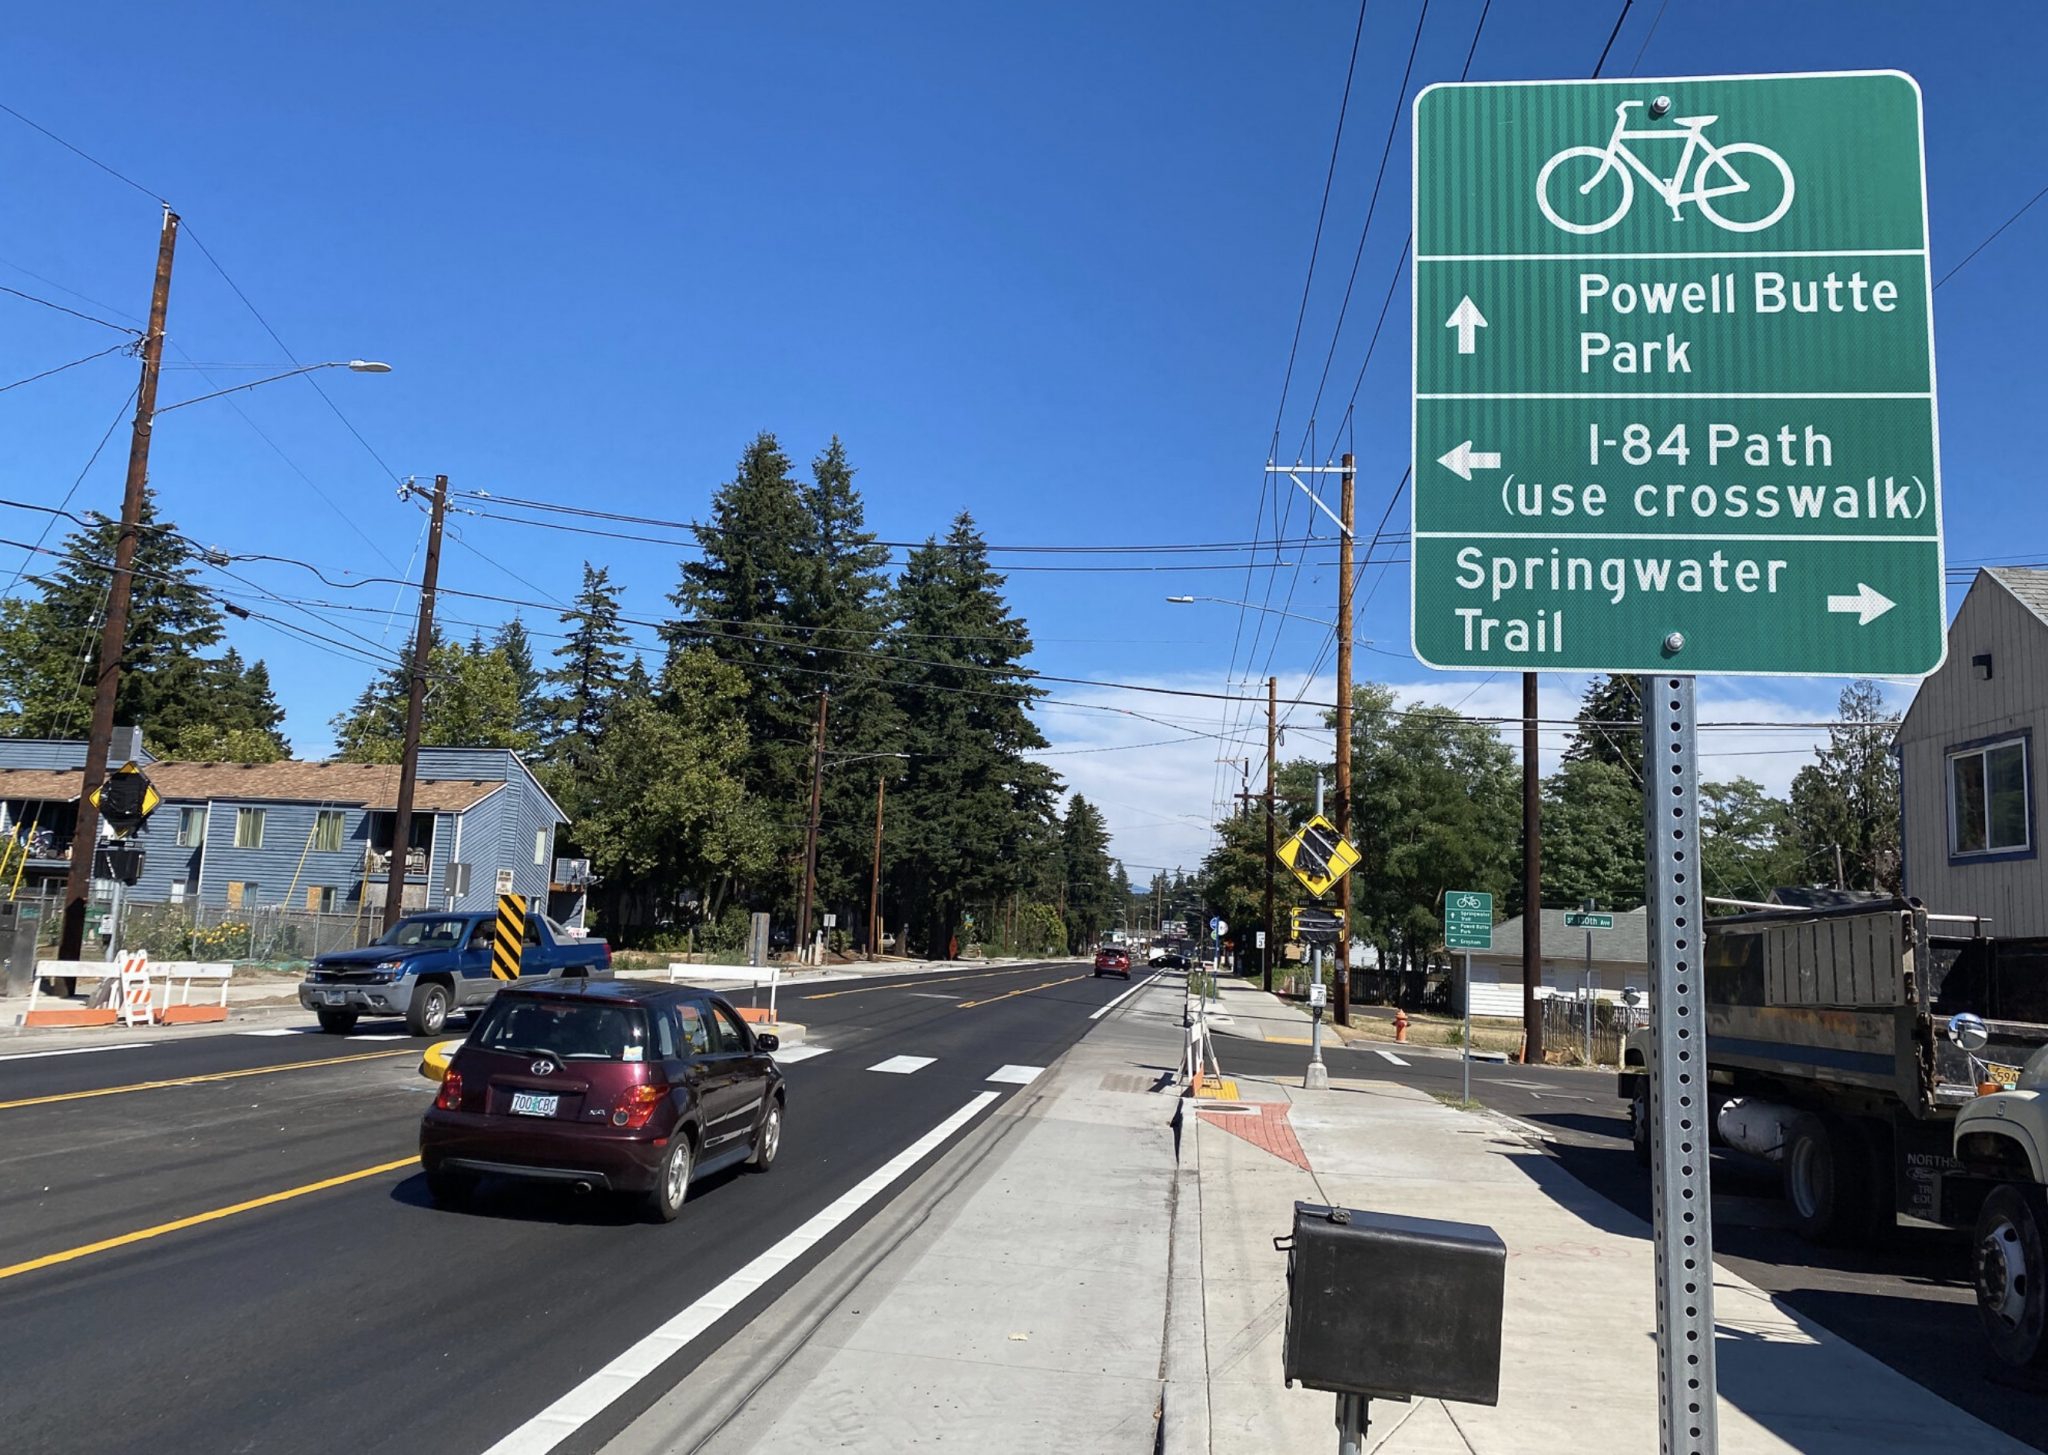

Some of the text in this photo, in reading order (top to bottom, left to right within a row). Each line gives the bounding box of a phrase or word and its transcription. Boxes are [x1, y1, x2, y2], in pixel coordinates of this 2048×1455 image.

[1579, 271, 1898, 315] Powell Butte
[1580, 332, 1692, 374] Park
[1590, 423, 1832, 467] I-84 Path
[1502, 473, 1927, 519] (use crosswalk)
[1455, 546, 1788, 605] Springwater
[1455, 608, 1562, 653] Trail
[514, 1095, 557, 1113] 700 CBC
